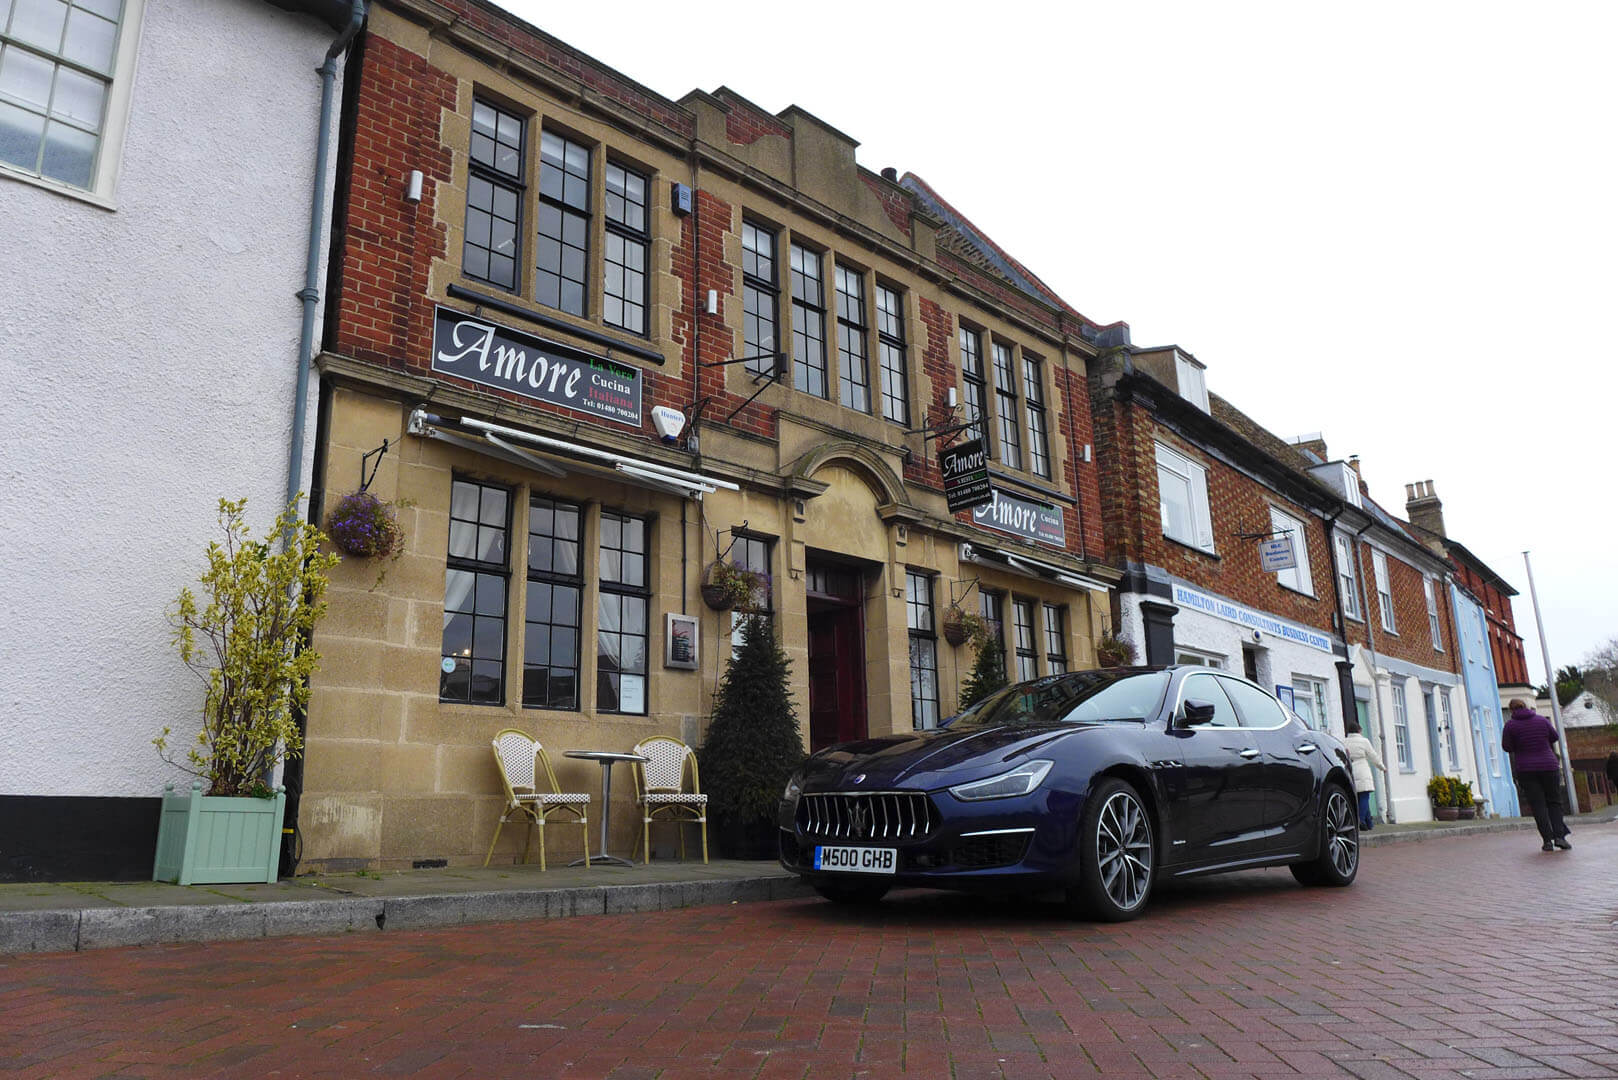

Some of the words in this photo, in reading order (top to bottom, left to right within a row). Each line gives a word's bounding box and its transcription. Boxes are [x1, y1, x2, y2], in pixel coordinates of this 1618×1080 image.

[438, 320, 582, 398] Amore
[589, 358, 604, 372] La
[608, 364, 633, 381] Vera
[591, 373, 631, 395] Cucina
[588, 385, 633, 409] Italiana
[596, 402, 616, 414] 01480
[943, 450, 984, 477] Amore
[975, 489, 1037, 533] Amore
[1176, 588, 1215, 612] HAMILTON
[1216, 602, 1237, 618] LAIRD
[1238, 610, 1281, 634] CONSULTANTS
[1282, 625, 1309, 643] BUSINESS
[1309, 635, 1329, 650] CENTRE
[822, 848, 858, 867] M500
[862, 849, 893, 868] GHB
